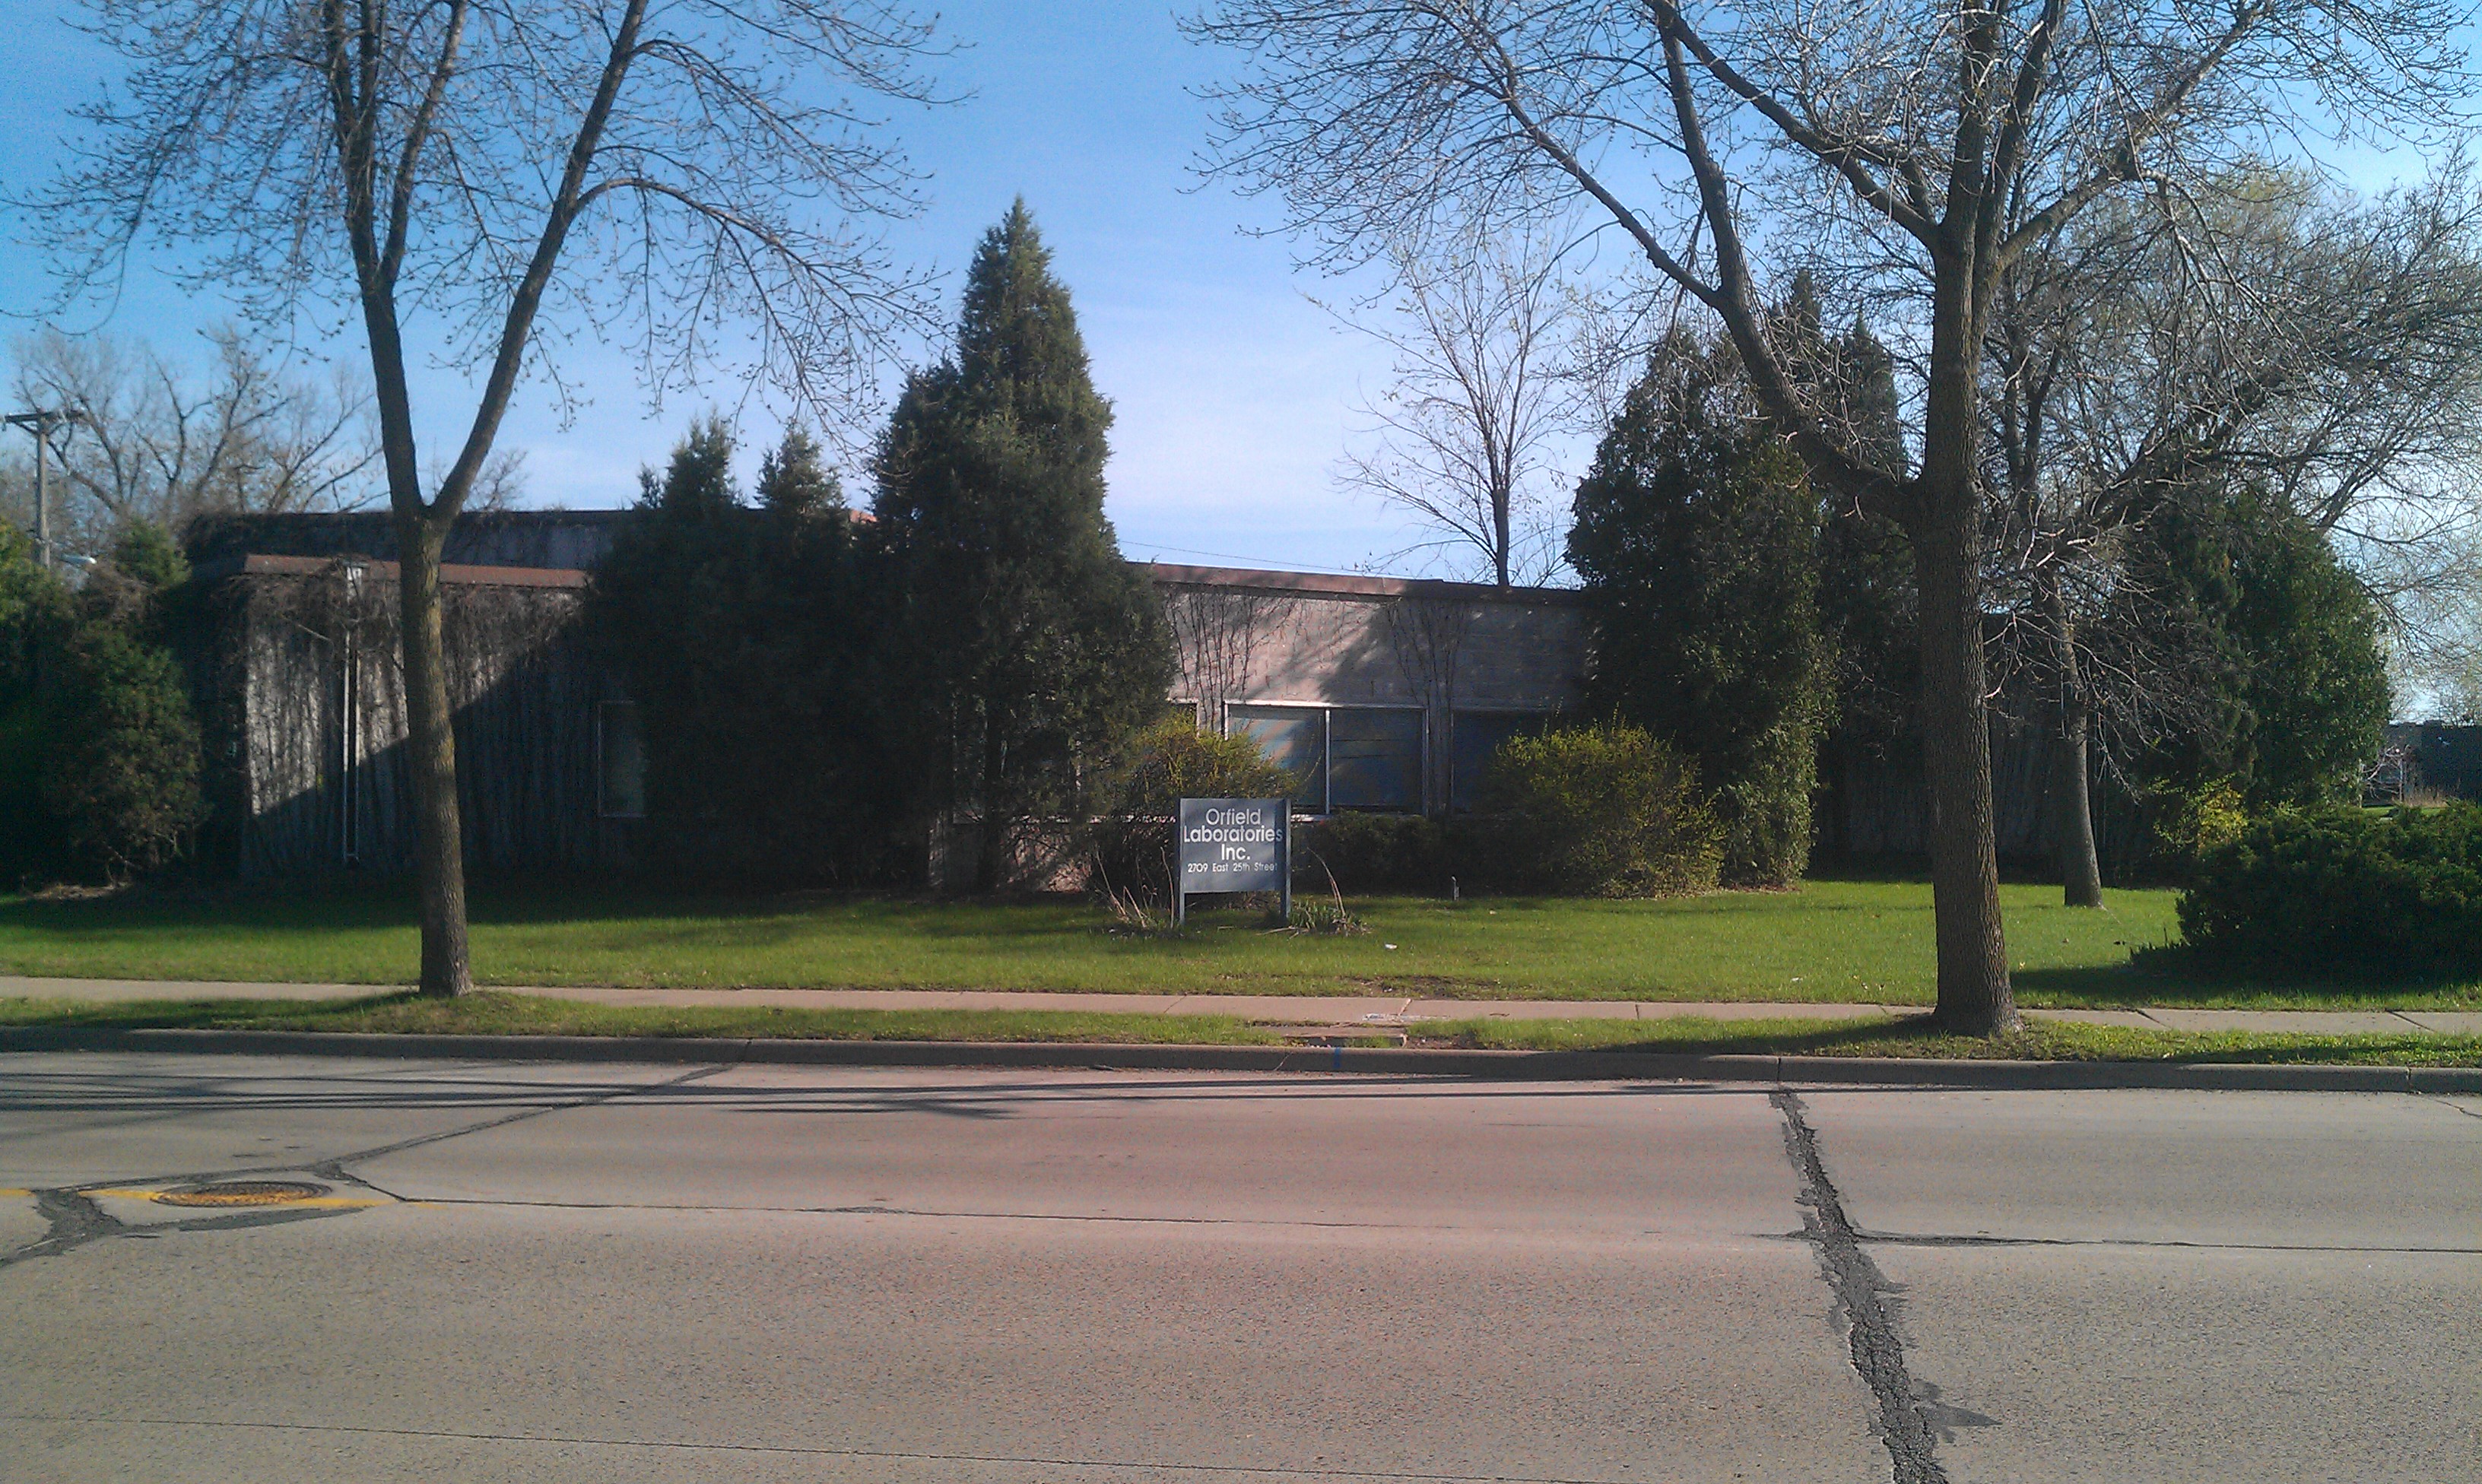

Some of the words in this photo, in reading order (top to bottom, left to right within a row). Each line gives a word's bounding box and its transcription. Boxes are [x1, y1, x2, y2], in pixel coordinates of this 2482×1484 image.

[1206, 808, 1261, 825] Orfield
[1184, 825, 1283, 842] Laboratories
[1221, 844, 1251, 861] Inc.
[1188, 863, 1208, 873] 2709
[1212, 863, 1229, 872] East
[1233, 862, 1250, 872] 25th
[1254, 862, 1278, 872] Street
